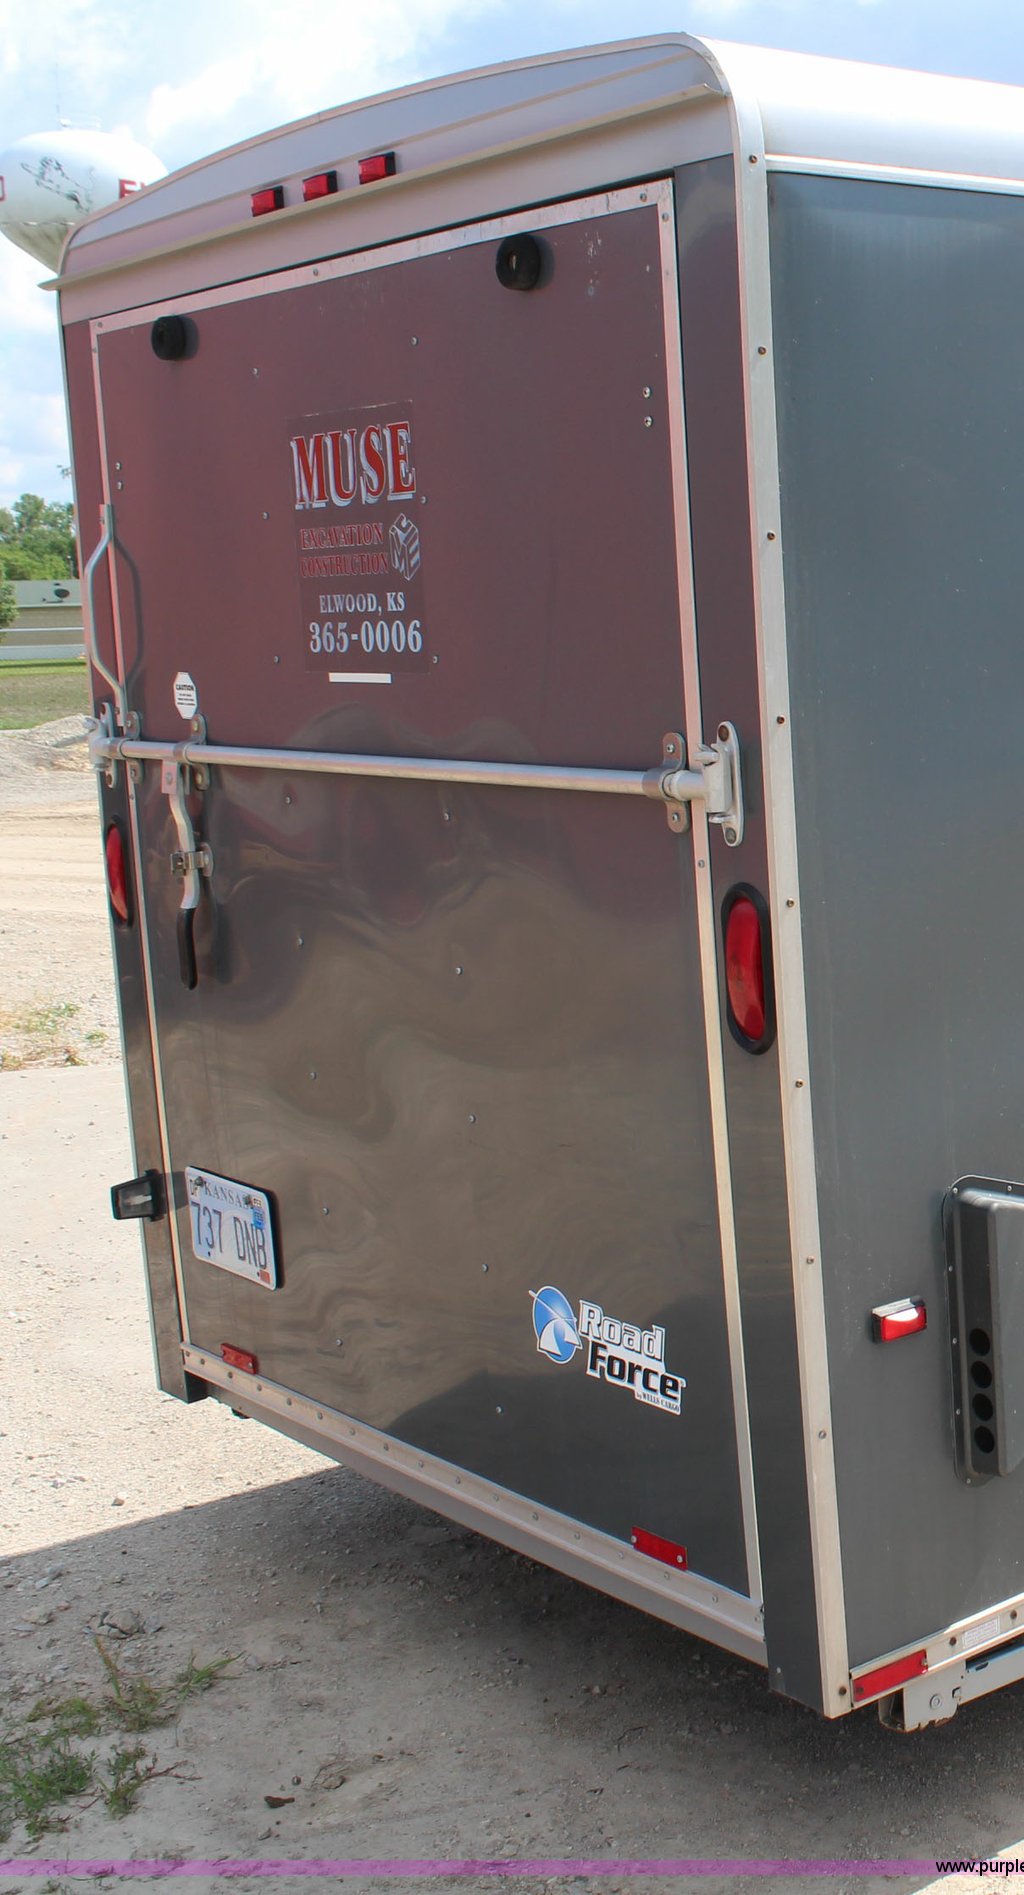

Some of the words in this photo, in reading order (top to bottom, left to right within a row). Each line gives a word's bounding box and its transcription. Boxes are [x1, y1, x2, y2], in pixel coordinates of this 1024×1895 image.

[290, 421, 417, 510] MUSE
[299, 522, 384, 550] EXCAVATION
[300, 552, 389, 578] CONSTRUCTION
[319, 593, 382, 616] ELWOOD,
[386, 592, 406, 612] KS
[309, 619, 423, 653] 365-0006
[191, 1200, 223, 1254] 737
[233, 1216, 268, 1270] DNB
[579, 1301, 666, 1362] Road
[588, 1340, 681, 1401] Force
